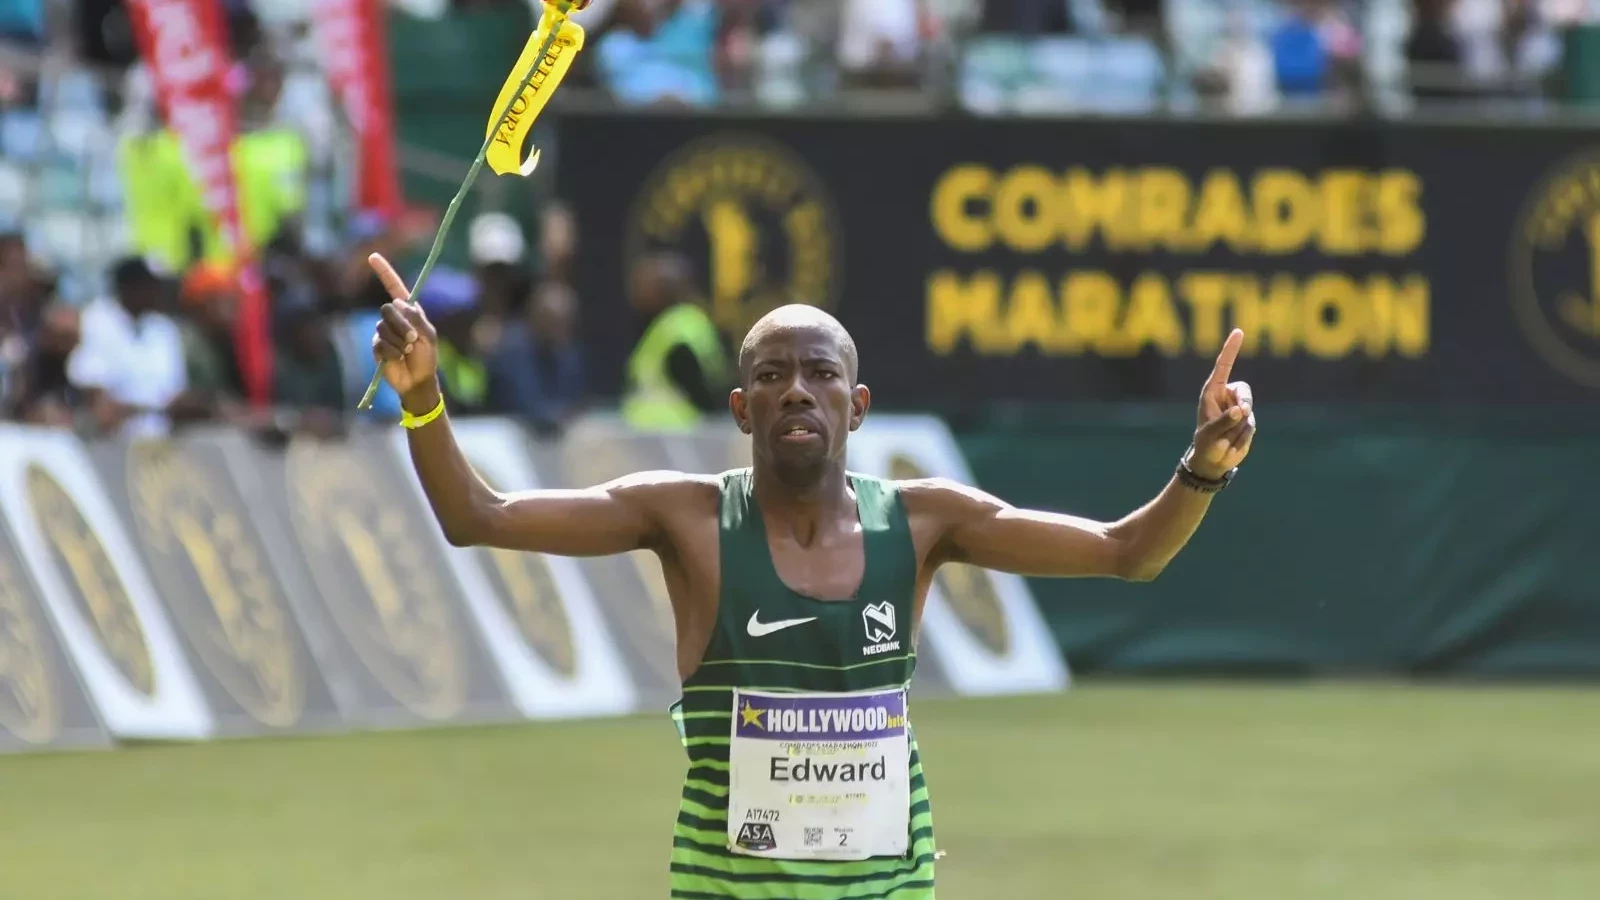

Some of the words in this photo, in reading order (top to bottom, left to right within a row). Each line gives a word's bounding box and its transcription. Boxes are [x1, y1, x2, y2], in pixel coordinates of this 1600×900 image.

[931, 164, 1425, 255] COMRADES
[926, 270, 1430, 358] MARATHON
[863, 641, 900, 656] NEDBANK
[770, 755, 886, 782] Edward
[746, 808, 780, 822] A17472
[740, 824, 773, 839] ASA
[839, 833, 847, 847] 2
